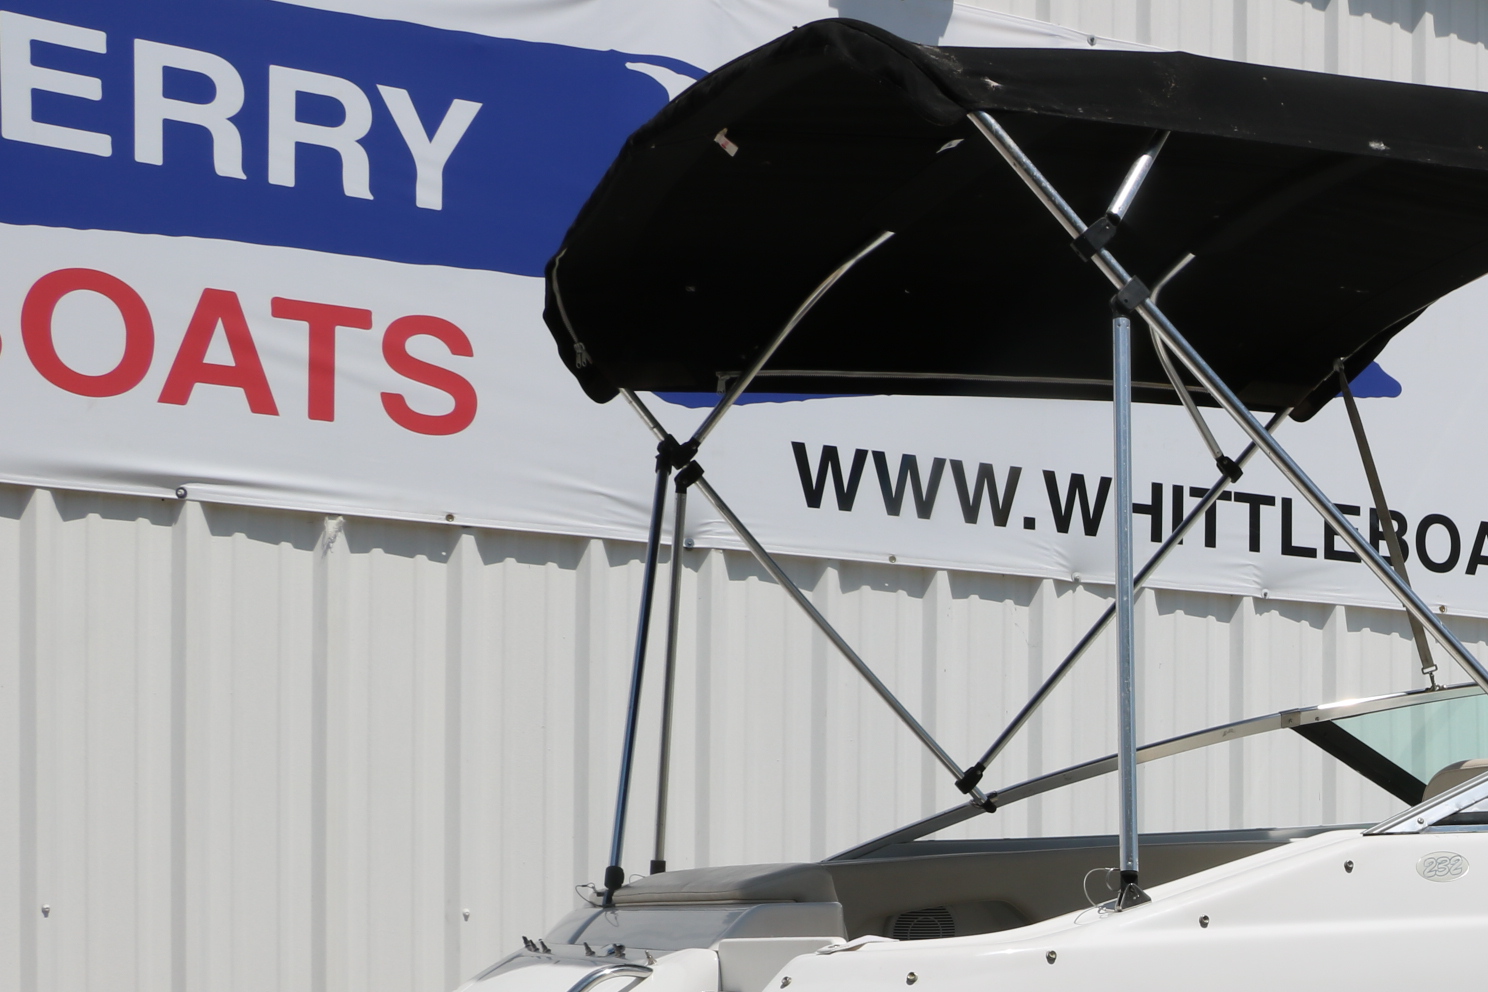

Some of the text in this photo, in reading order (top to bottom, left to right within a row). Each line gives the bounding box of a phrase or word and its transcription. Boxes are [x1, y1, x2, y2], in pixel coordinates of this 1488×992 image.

[0, 9, 482, 211] ERRY
[0, 267, 479, 436] OATS
[1423, 854, 1463, 879] 232
